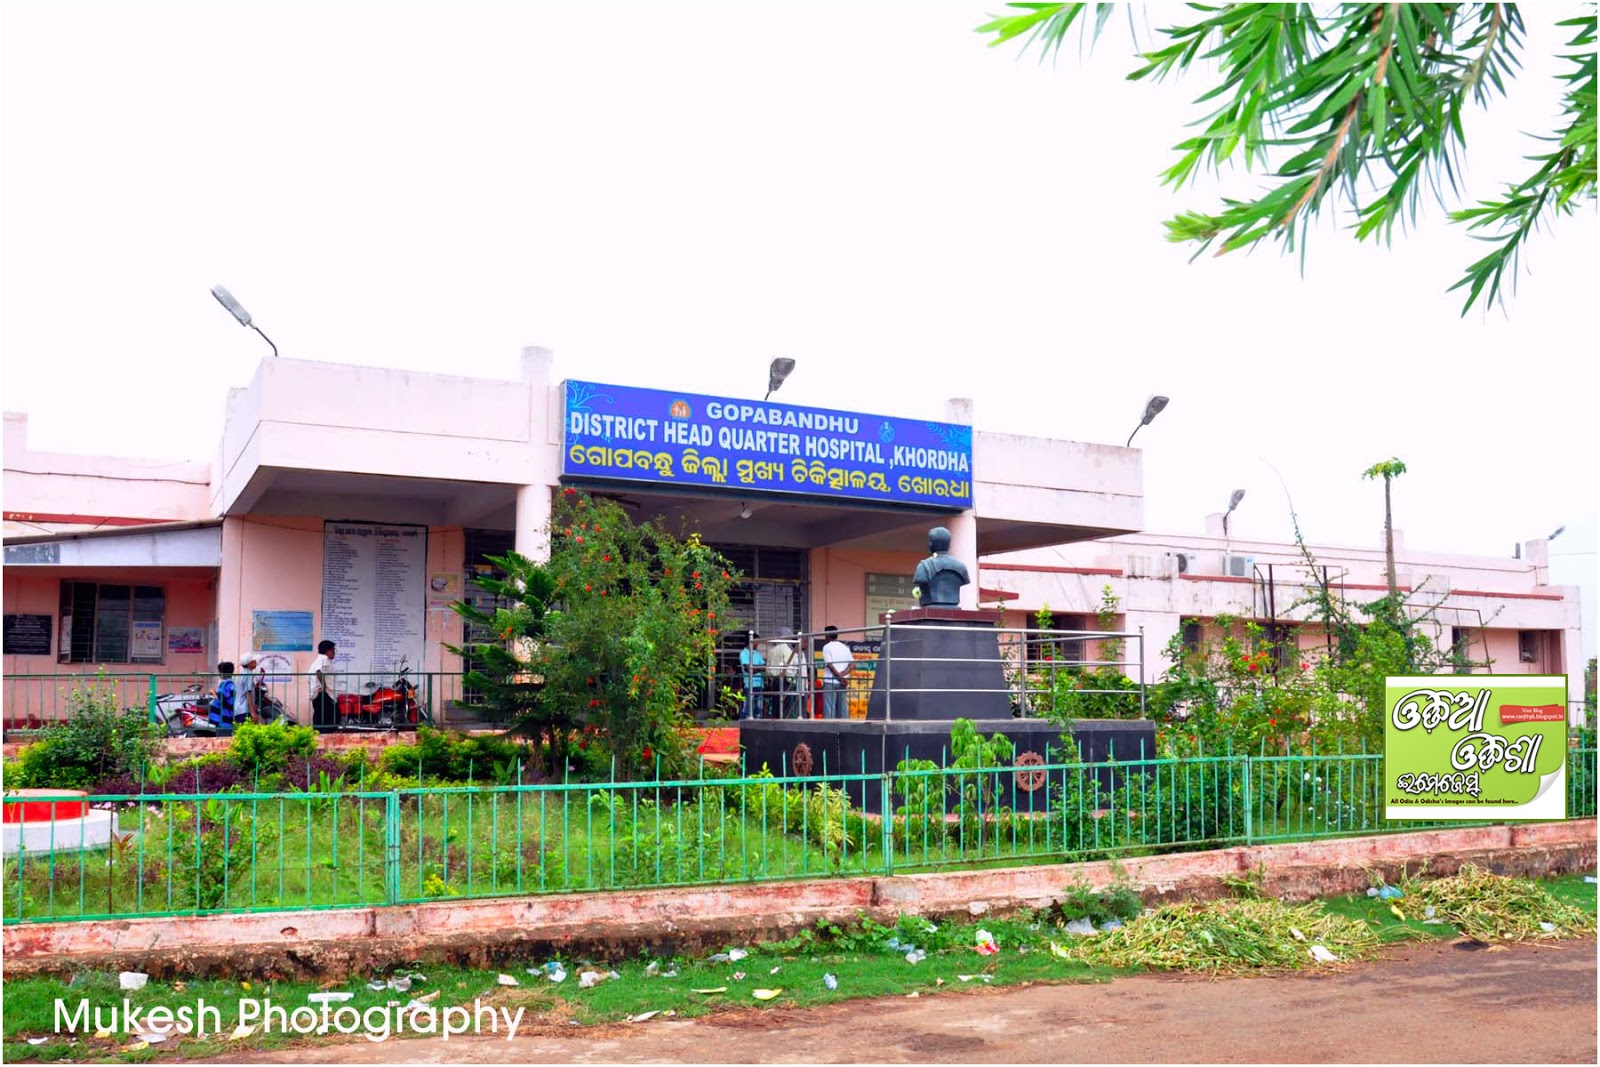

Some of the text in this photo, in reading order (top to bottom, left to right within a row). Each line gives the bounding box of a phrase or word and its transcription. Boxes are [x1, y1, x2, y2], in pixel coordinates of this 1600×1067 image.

[570, 411, 658, 443] DISTRICT
[663, 419, 713, 447] HEAD
[718, 426, 800, 456] QUARTER
[805, 435, 885, 464] HOSPITAL
[706, 401, 859, 435] GOPABANDHU
